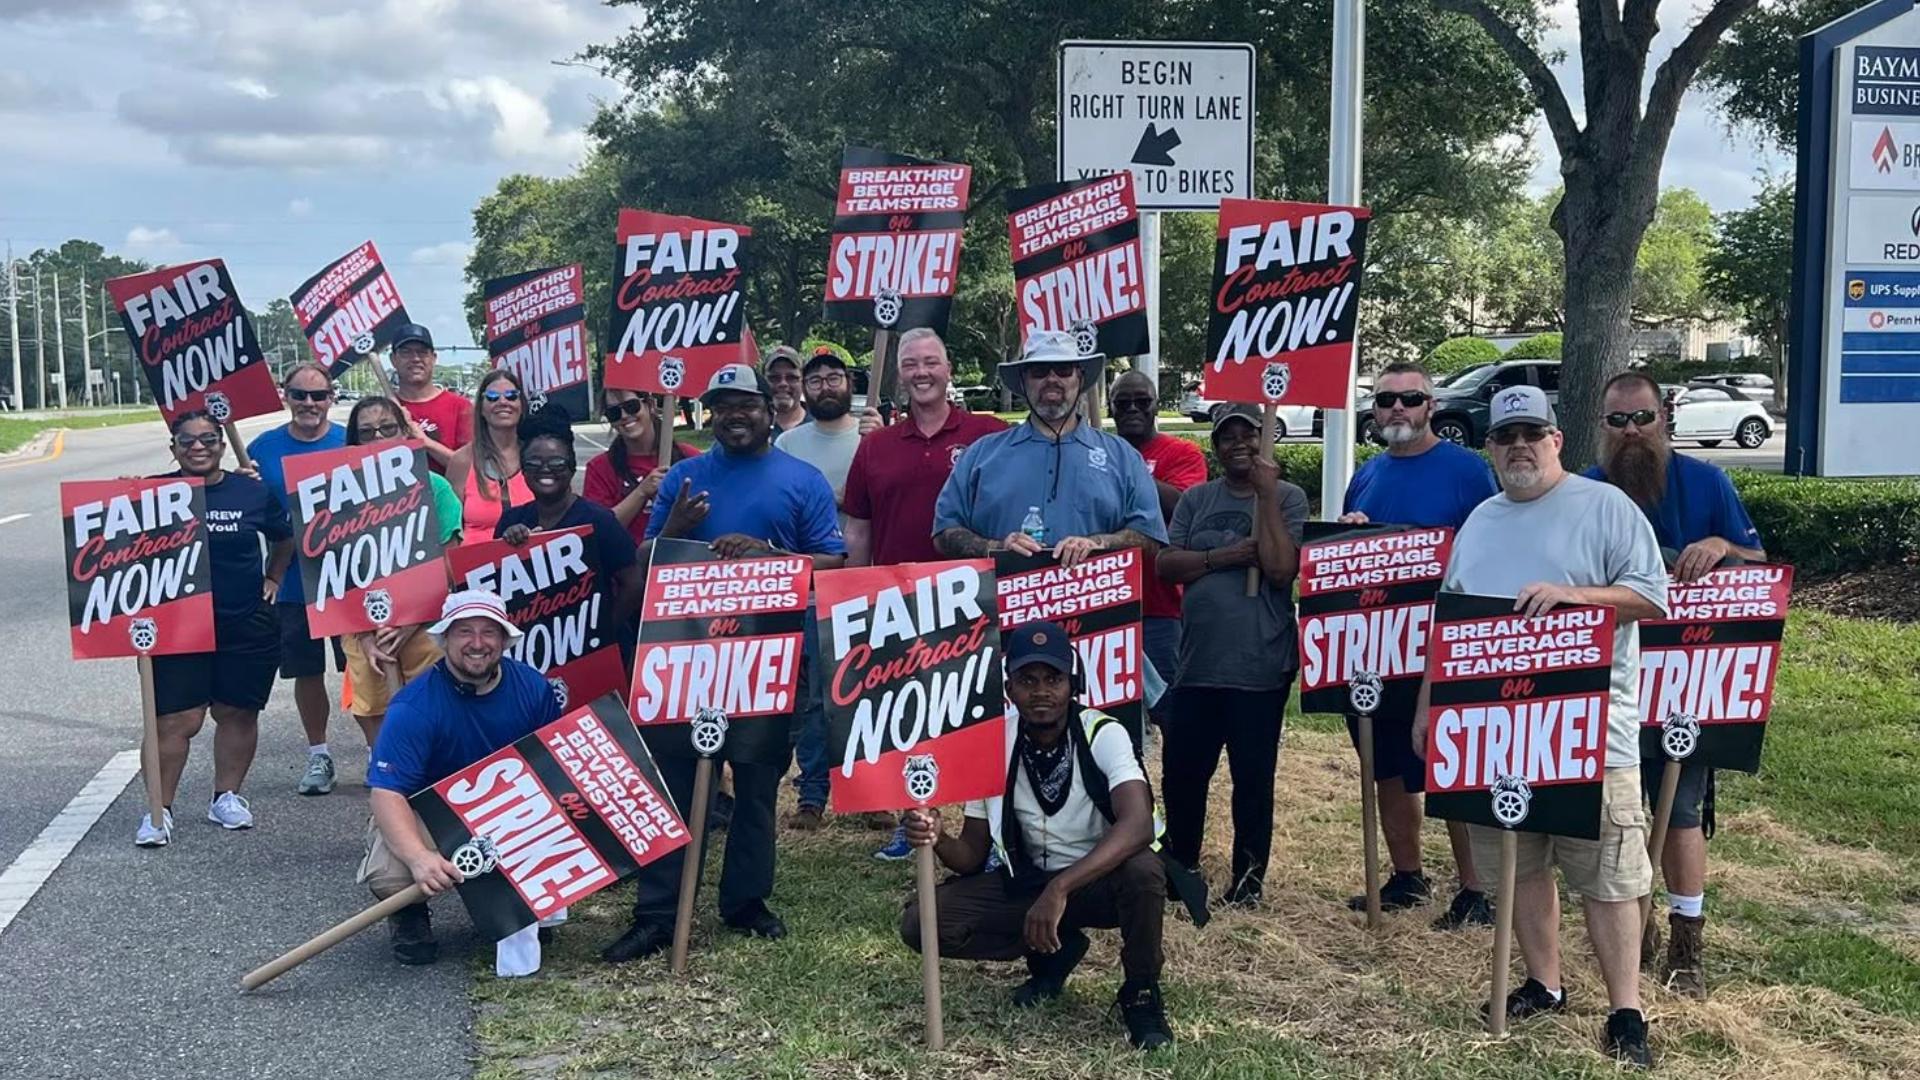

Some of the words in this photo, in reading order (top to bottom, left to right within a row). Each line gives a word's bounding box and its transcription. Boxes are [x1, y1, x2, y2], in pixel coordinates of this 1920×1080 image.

[1122, 60, 1192, 85] BEGIN
[1070, 94, 1124, 118] RIGHT
[1137, 95, 1184, 120] TURN
[1196, 96, 1242, 120] LANE
[848, 168, 965, 184] BREAKTHRU
[853, 183, 954, 198] BEVERAGE
[1144, 170, 1167, 193] TO
[1178, 170, 1235, 194] BIKES
[846, 196, 959, 212] TEAMSTERS
[888, 215, 913, 231] on
[1014, 176, 1127, 228] BREAKTHRU
[1023, 194, 1122, 240] BEVERAGE
[624, 228, 739, 276] FAIR
[1019, 206, 1130, 256] TEAMSTERS
[1062, 238, 1088, 261] on
[1225, 210, 1355, 276] FAIR
[1884, 243, 1920, 260] RED
[297, 244, 370, 310] BREAKTHRU
[304, 255, 369, 315] BEVERAGE
[832, 232, 956, 298] STRIKE!
[1217, 254, 1358, 314] Contract
[124, 264, 226, 338] FAIR
[304, 258, 376, 322] TEAMSTERS
[489, 267, 576, 312] BREAKTHRU
[495, 281, 571, 323] BEVERAGE
[617, 267, 742, 310] Contract
[1022, 243, 1140, 334] STRIKE!
[1870, 284, 1890, 295] UPS
[142, 297, 234, 366] Contract
[314, 274, 400, 367] STRIKE!
[492, 292, 576, 336] TEAMSTERS
[524, 322, 541, 339] on
[615, 290, 740, 364] NOW!
[1214, 282, 1354, 373] NOW!
[1887, 314, 1912, 325] Penn
[162, 315, 249, 412] NOW!
[297, 445, 418, 524] FAIR
[73, 481, 194, 548] FAIR
[302, 480, 424, 558] Contract
[73, 516, 200, 582] Contract
[316, 505, 429, 612] NOW!
[1308, 530, 1446, 562] BREAKTHRU
[1316, 548, 1436, 576] BEVERAGE
[80, 540, 202, 634] NOW!
[656, 560, 804, 583] BREAKTHRU
[663, 576, 793, 600] BEVERAGE
[997, 552, 1134, 596] BREAKTHRU
[1006, 570, 1126, 610] BEVERAGE
[1307, 562, 1442, 592] TEAMSTERS
[654, 593, 798, 616] TEAMSTERS
[831, 564, 984, 661] FAIR
[998, 585, 1132, 627] TEAMSTERS
[1359, 588, 1389, 607] on
[1670, 586, 1772, 604] VERAGE
[503, 592, 601, 675] OW!
[708, 618, 740, 636] on
[1442, 609, 1606, 642] BREAKTHRU
[1450, 628, 1594, 659] BEVERAGE
[1682, 626, 1714, 644] on
[638, 636, 796, 722] STRIKE!
[831, 614, 990, 706] Contract
[1442, 646, 1602, 677] TEAMSTERS
[1500, 678, 1536, 699] on
[1639, 646, 1772, 722] TRIKE!
[842, 646, 994, 779] NOW!
[1432, 696, 1602, 789] STRIKE!
[548, 732, 650, 856] TEAMSTERS
[566, 730, 661, 841] BEVERAGE
[577, 714, 684, 840] BREAKTHRU
[559, 792, 589, 820] on
[446, 757, 609, 910] STRIKE!
